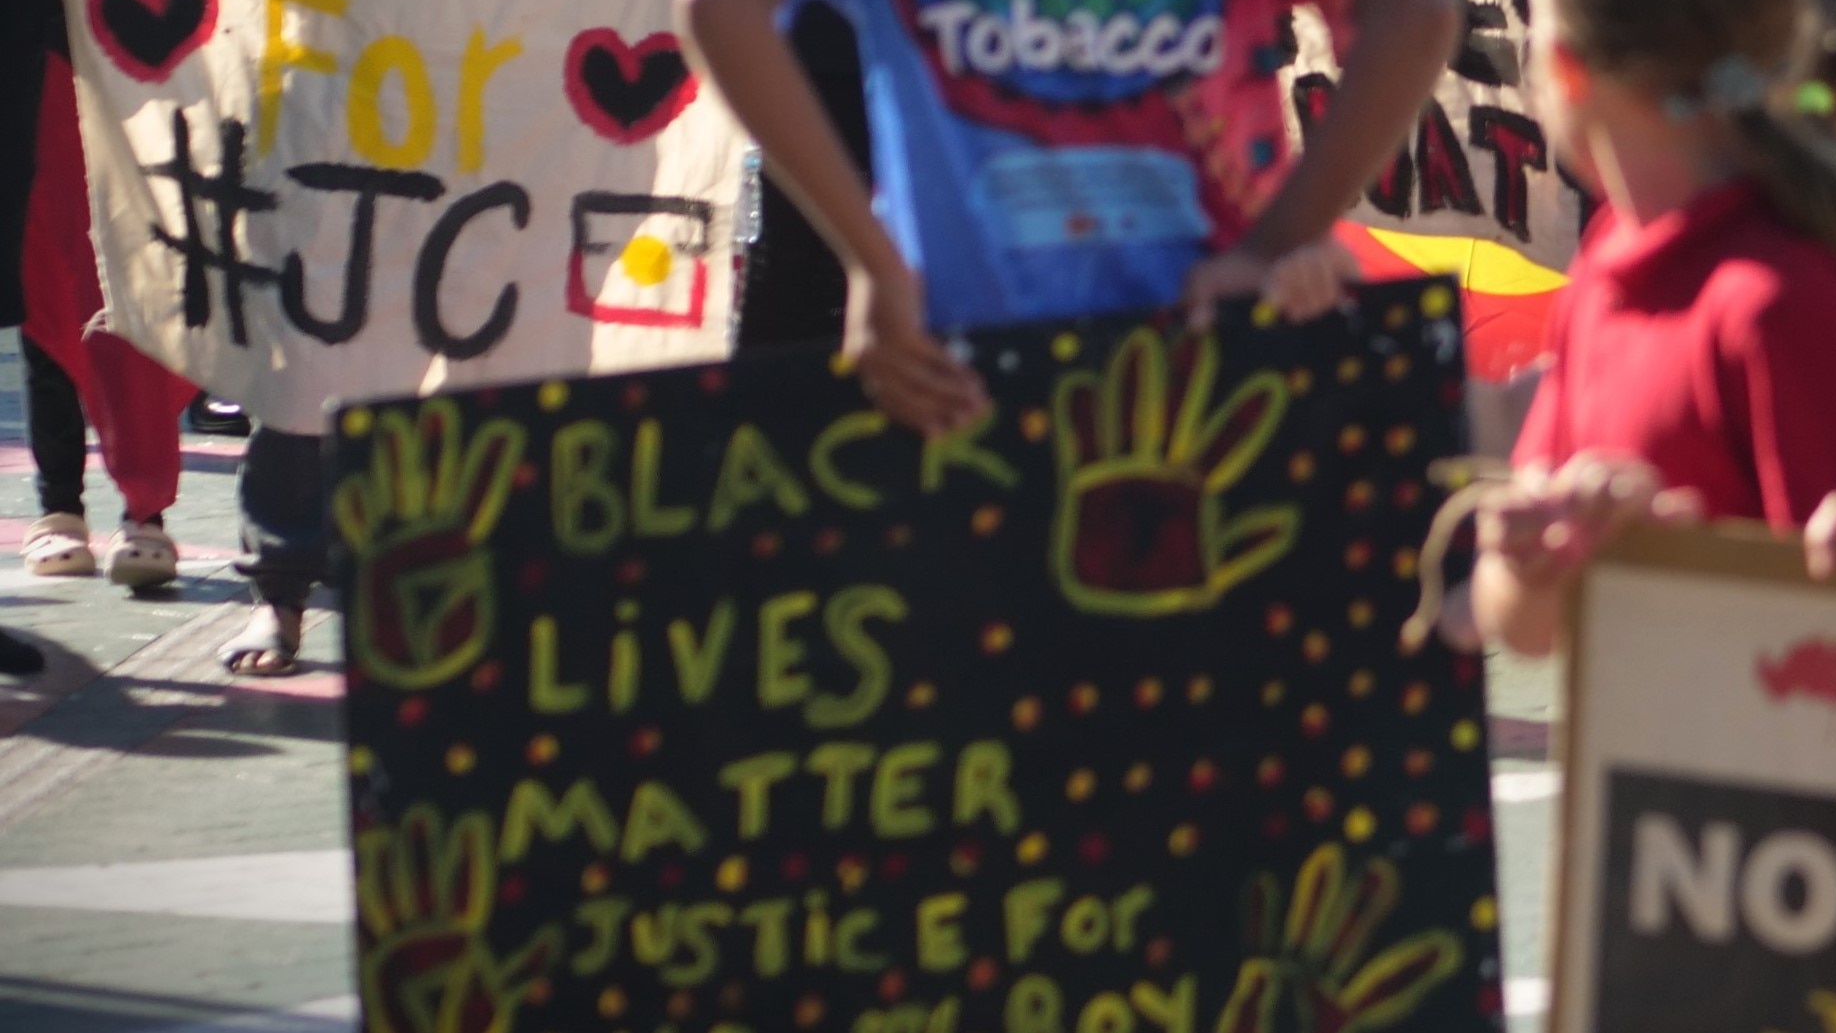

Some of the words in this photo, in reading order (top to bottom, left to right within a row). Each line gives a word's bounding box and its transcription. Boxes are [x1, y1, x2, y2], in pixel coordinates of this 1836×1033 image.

[145, 106, 532, 360] #JC
[551, 411, 1020, 556] BLACK
[500, 739, 1020, 864] MATTER
